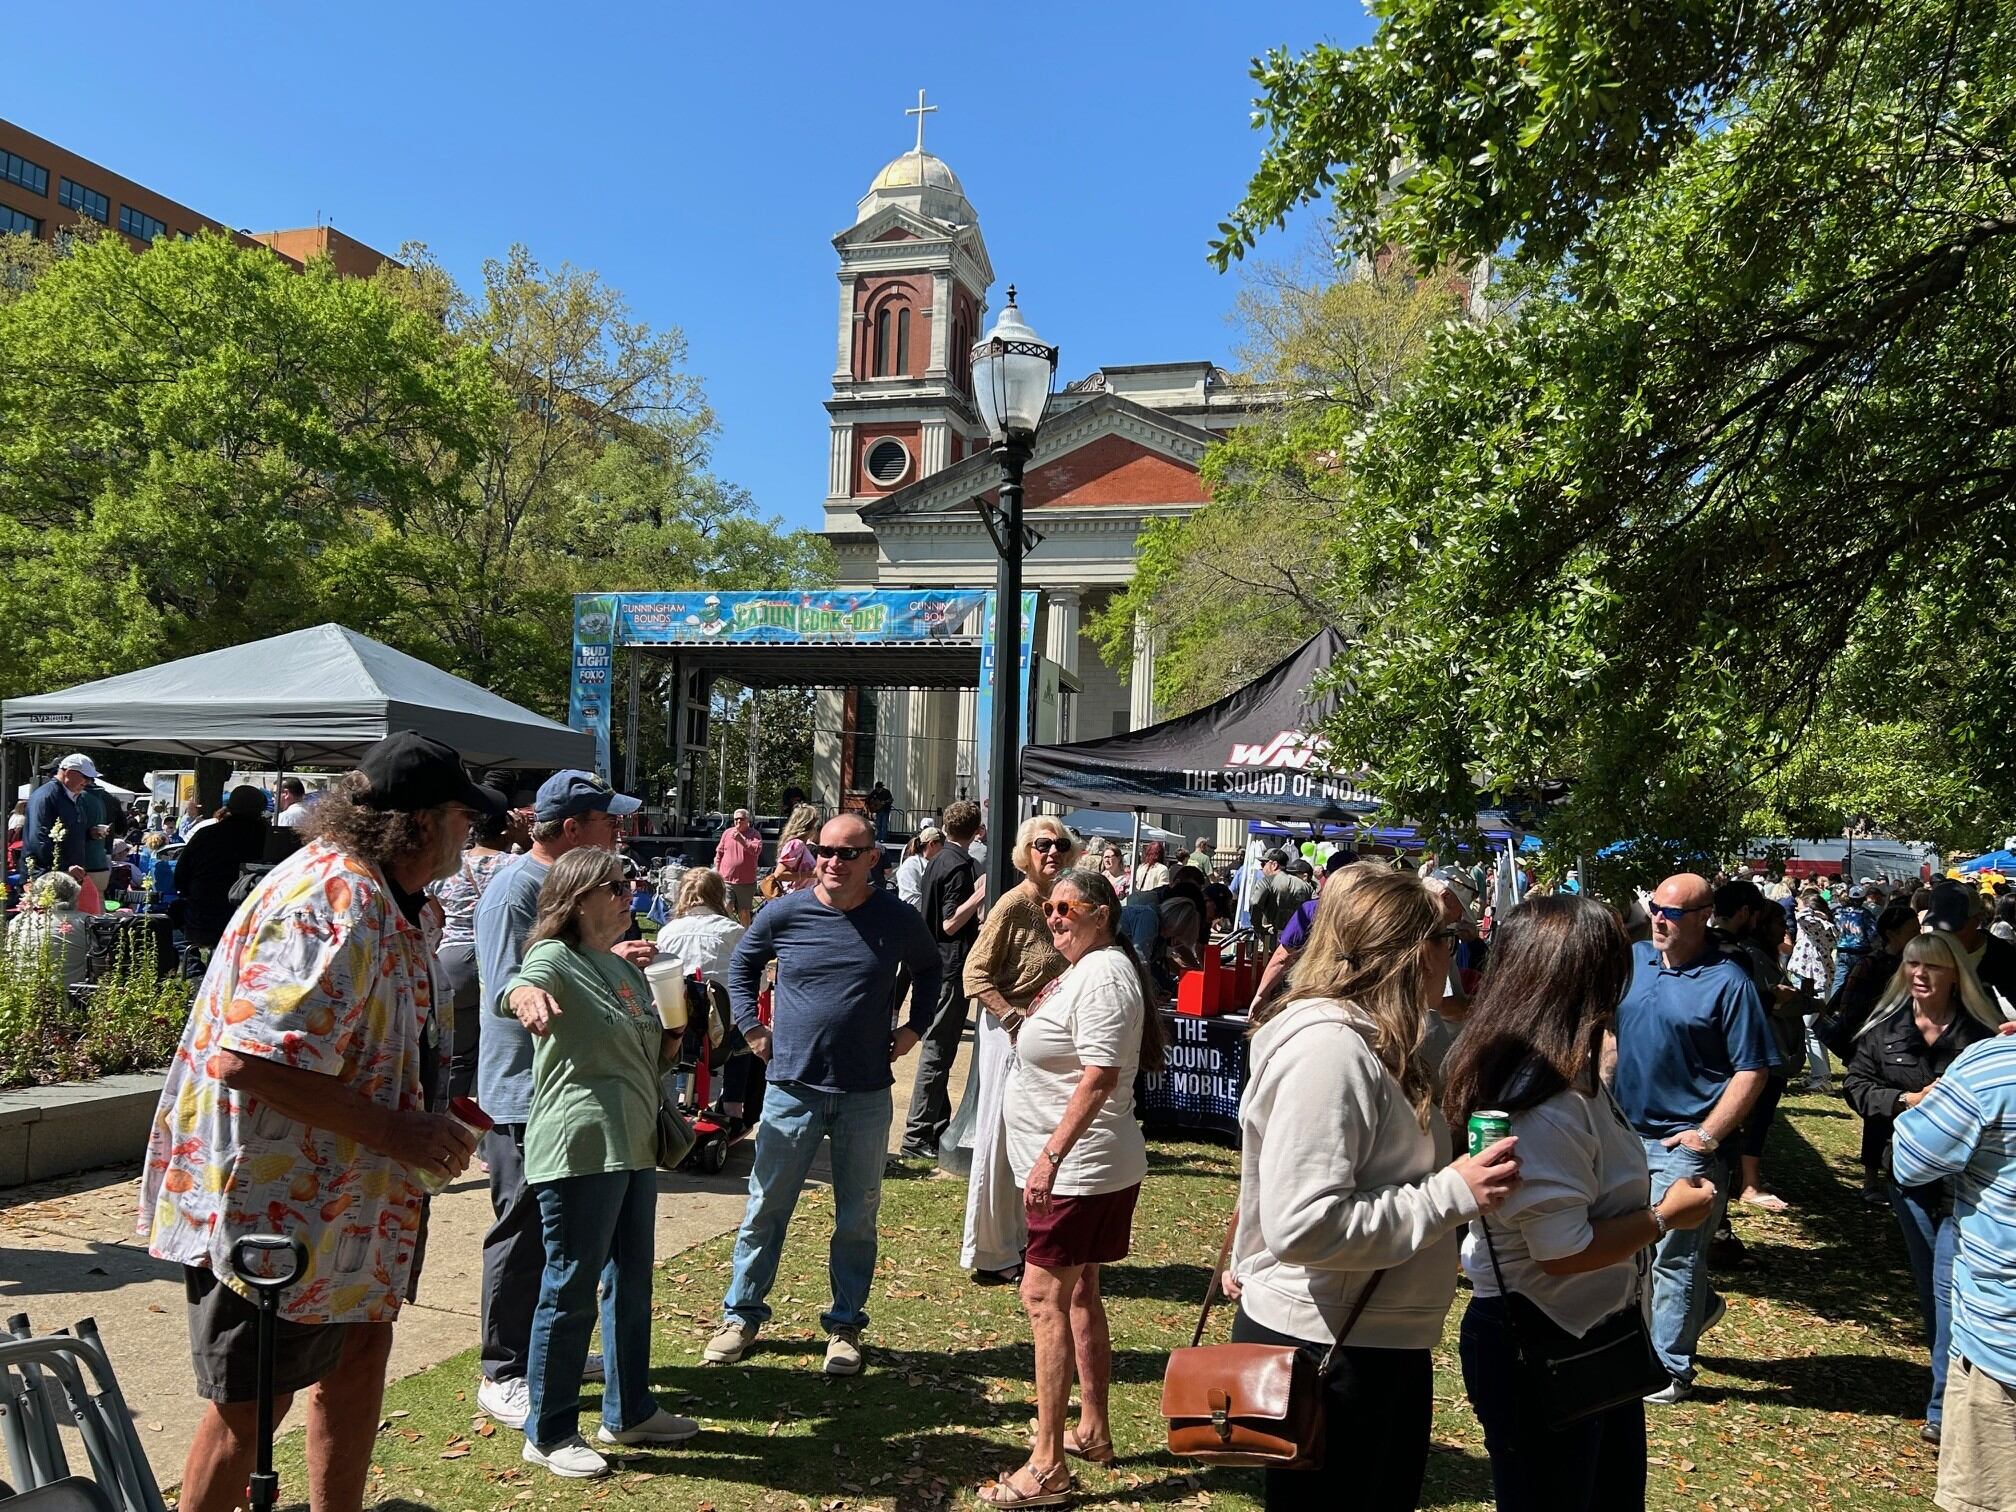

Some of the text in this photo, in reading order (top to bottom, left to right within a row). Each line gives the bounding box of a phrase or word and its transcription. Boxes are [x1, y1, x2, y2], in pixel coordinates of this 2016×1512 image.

[622, 604, 686, 613] CUNNINGHAM
[909, 601, 948, 611] CUNNIN
[634, 614, 671, 623] BOUNDS
[800, 603, 886, 632] COOK-OFF
[924, 612, 945, 621] BOU
[581, 646, 606, 656] BUD
[577, 656, 609, 667] LIGHT
[1183, 769, 1216, 792] THE
[1223, 771, 1286, 795] SOUND
[1292, 775, 1317, 798] OF
[1173, 1018, 1208, 1041] THE
[1163, 1045, 1220, 1070] SOUND
[1146, 1073, 1238, 1100] OF MOBILE
